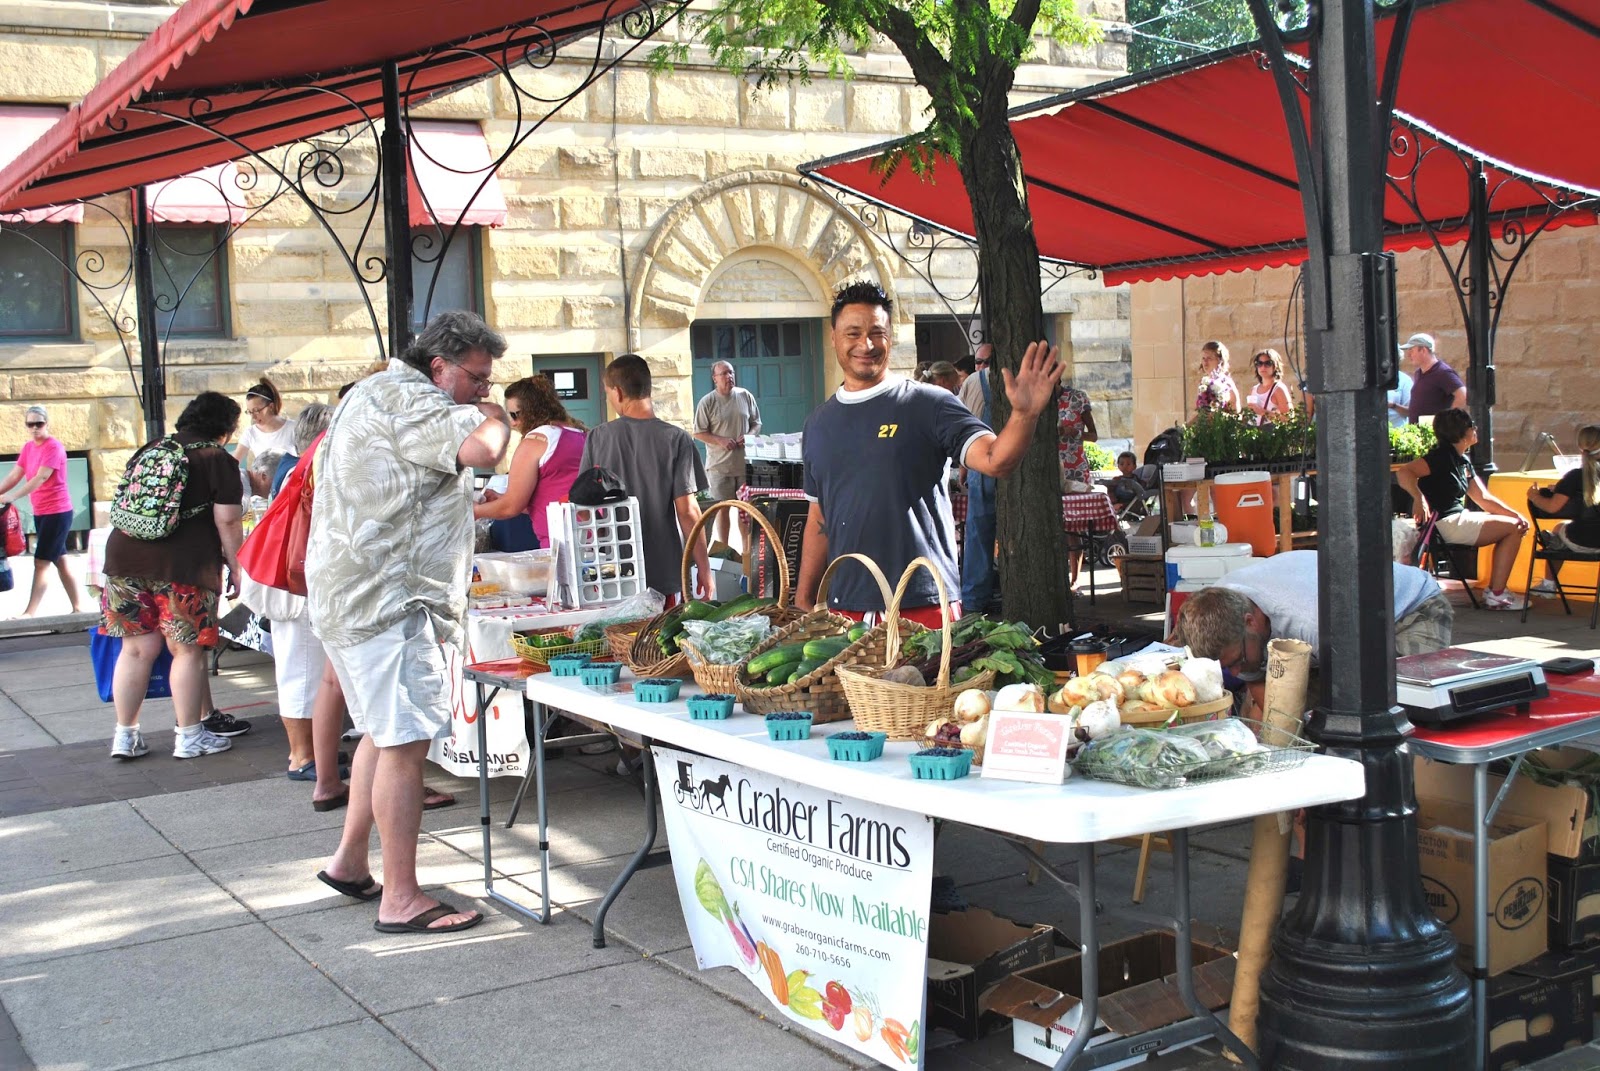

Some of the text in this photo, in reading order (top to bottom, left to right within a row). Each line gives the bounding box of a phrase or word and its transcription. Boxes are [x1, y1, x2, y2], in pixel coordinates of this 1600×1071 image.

[878, 424, 898, 438] 27
[786, 521, 802, 580] TOMATOES
[738, 778, 911, 868] Graber Farms
[1418, 834, 1448, 848] ECTION
[766, 838, 872, 881] Certified Organic Produce
[730, 856, 926, 943] CSA Shares Now Available
[762, 914, 891, 962] www.graberorganicfarms.com
[796, 943, 851, 968] 260-710-5656
